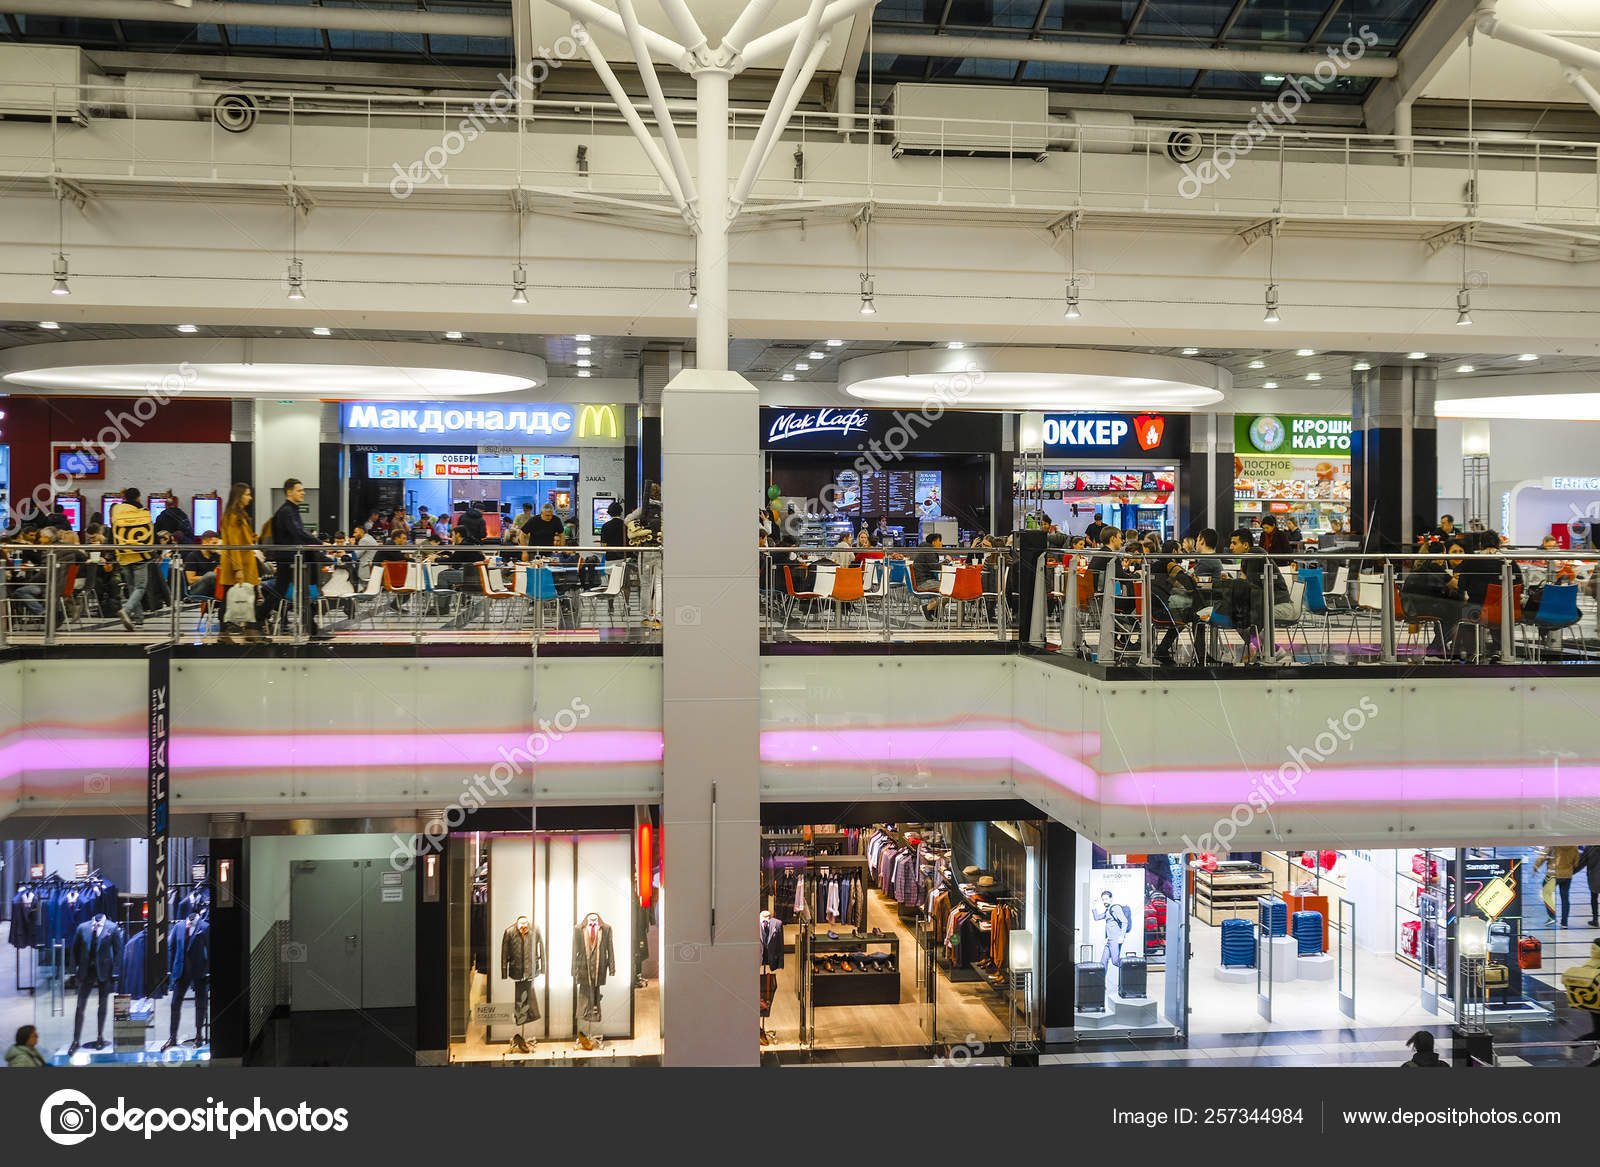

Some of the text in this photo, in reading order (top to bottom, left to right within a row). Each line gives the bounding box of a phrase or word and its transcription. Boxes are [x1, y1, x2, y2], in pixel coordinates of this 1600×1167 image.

[348, 404, 572, 435] Макдоналдс
[1043, 419, 1129, 446] ОККЕР
[1292, 435, 1351, 449] КАРТО
[442, 455, 476, 463] СОБЕРИ
[1244, 460, 1291, 470] ПОСТНОЕ
[1244, 469, 1276, 477] комбо
[155, 685, 167, 954] ТЕХНОПАРК
